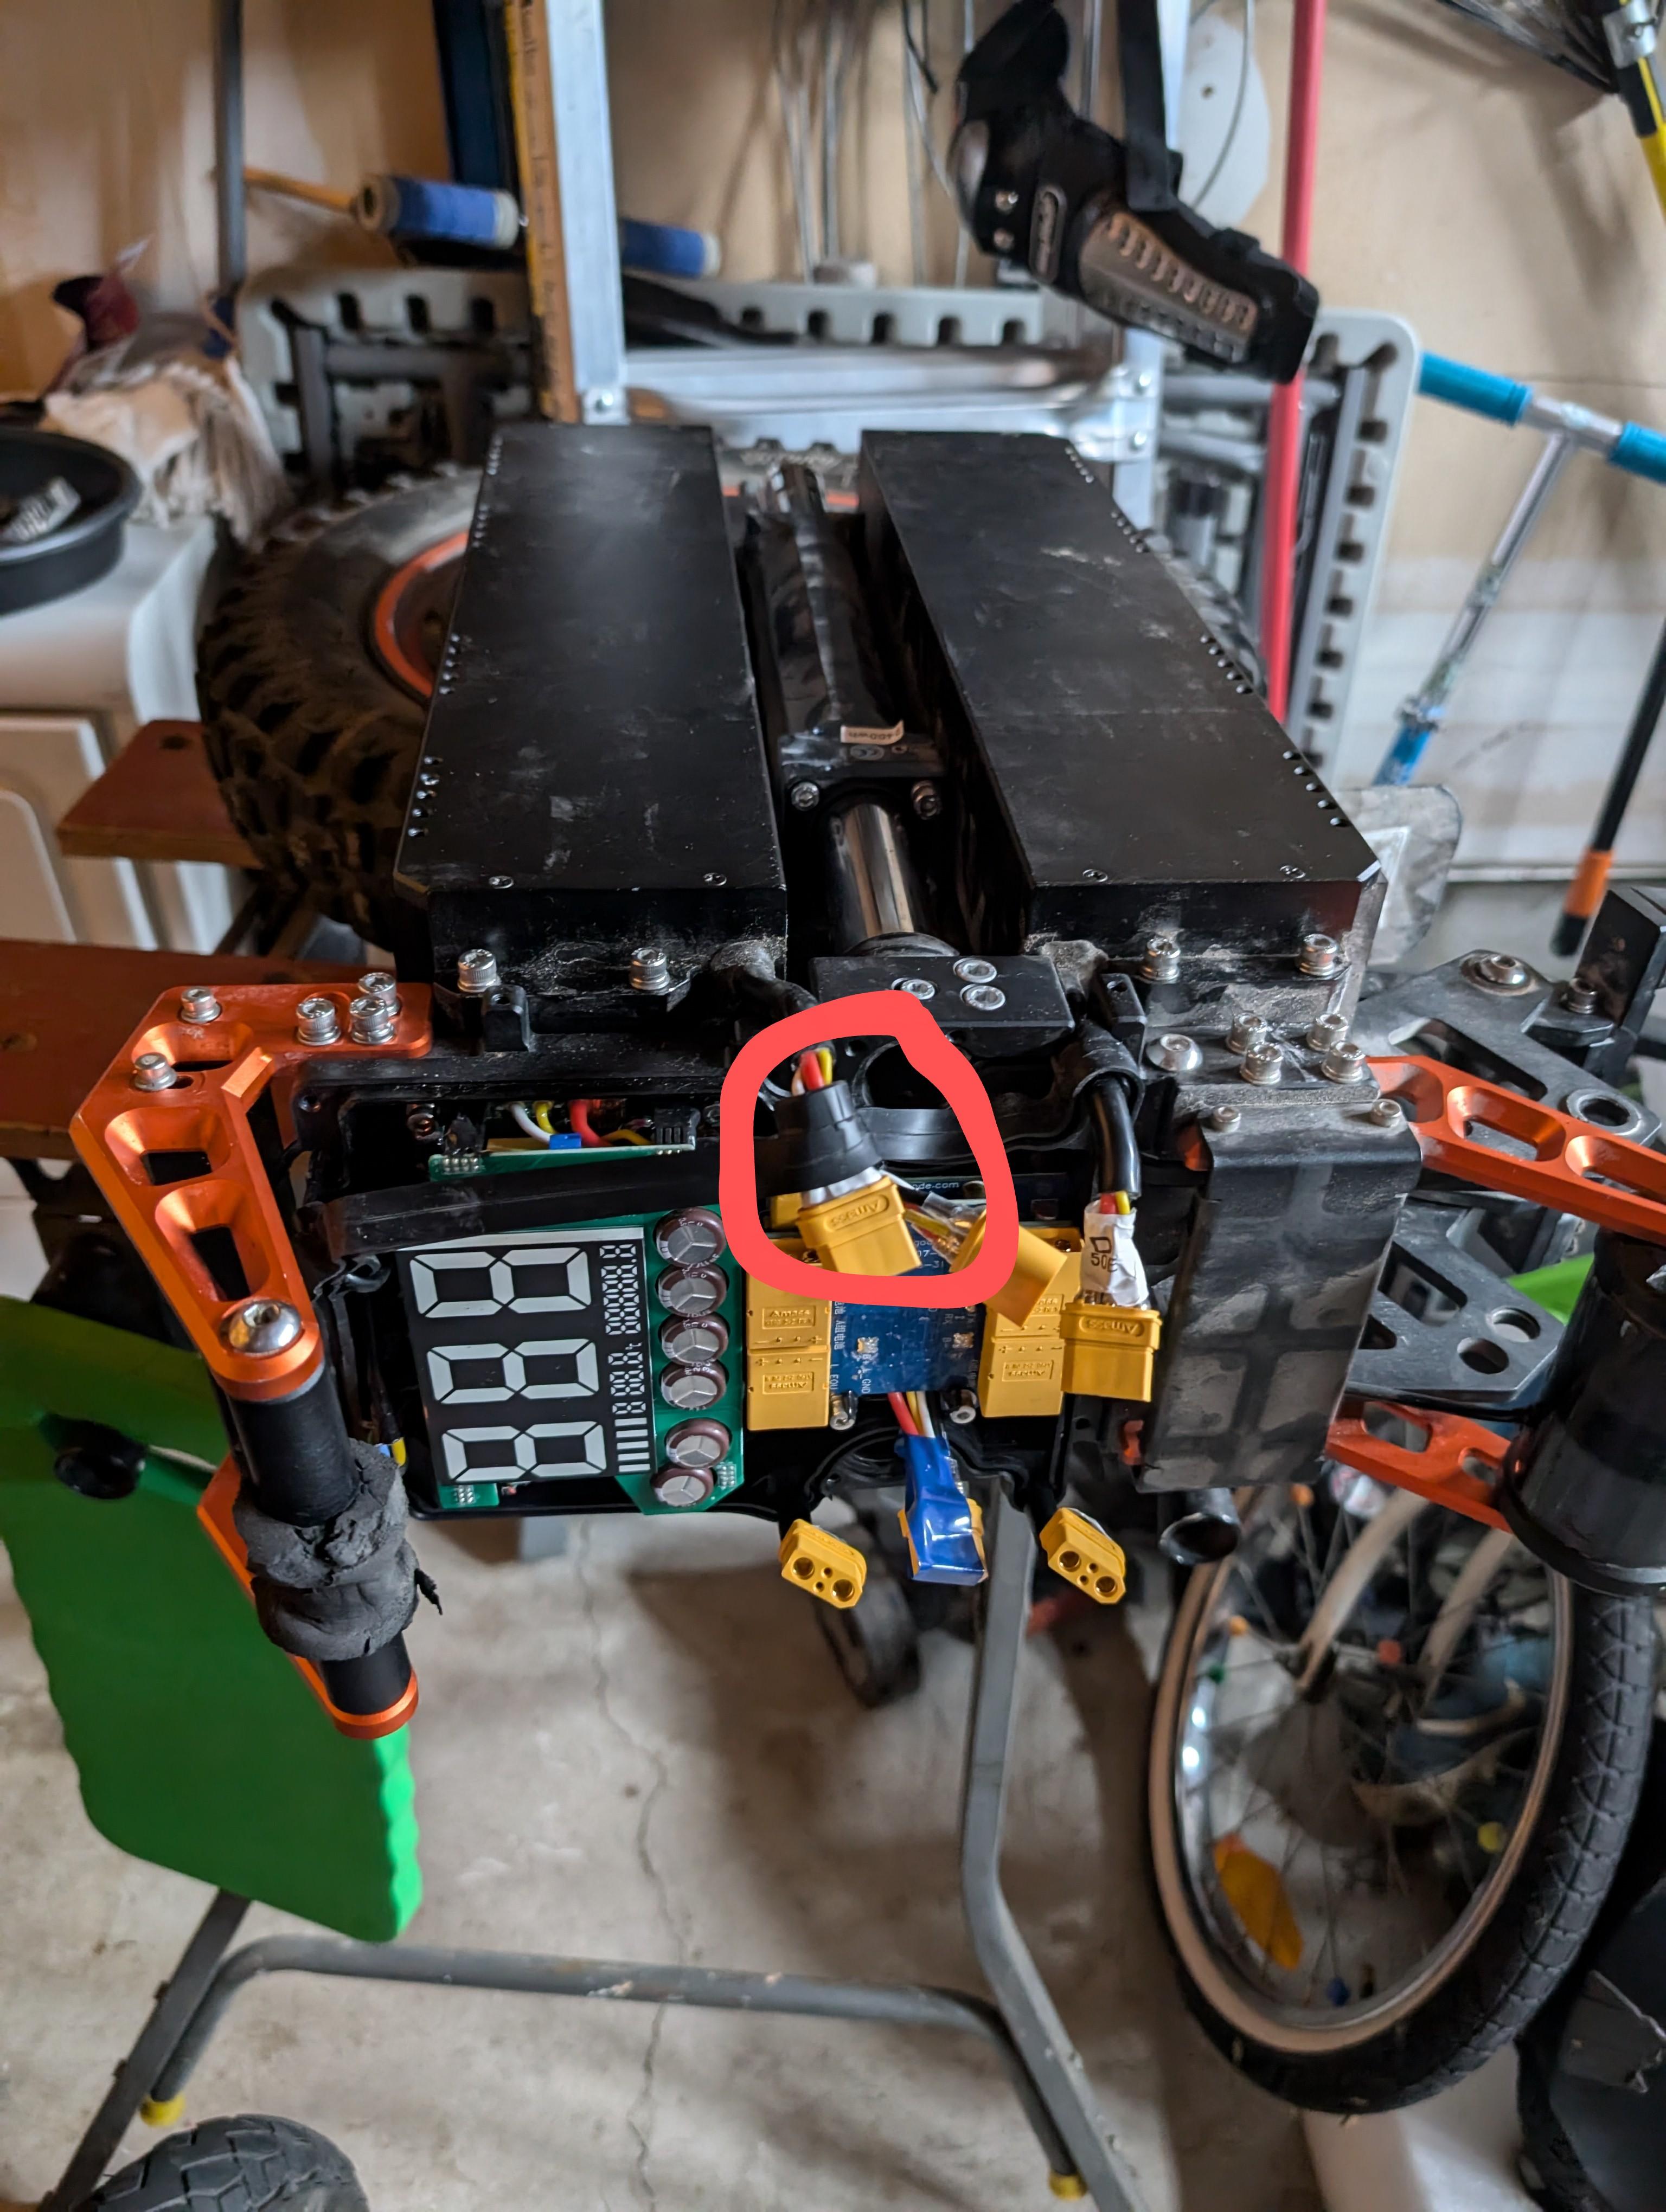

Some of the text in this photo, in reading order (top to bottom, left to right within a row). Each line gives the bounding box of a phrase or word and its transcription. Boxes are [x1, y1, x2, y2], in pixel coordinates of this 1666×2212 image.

[830, 1199, 882, 1227] Amass
[769, 1309, 811, 1317] Amass
[1086, 1319, 1139, 1335] Amass
